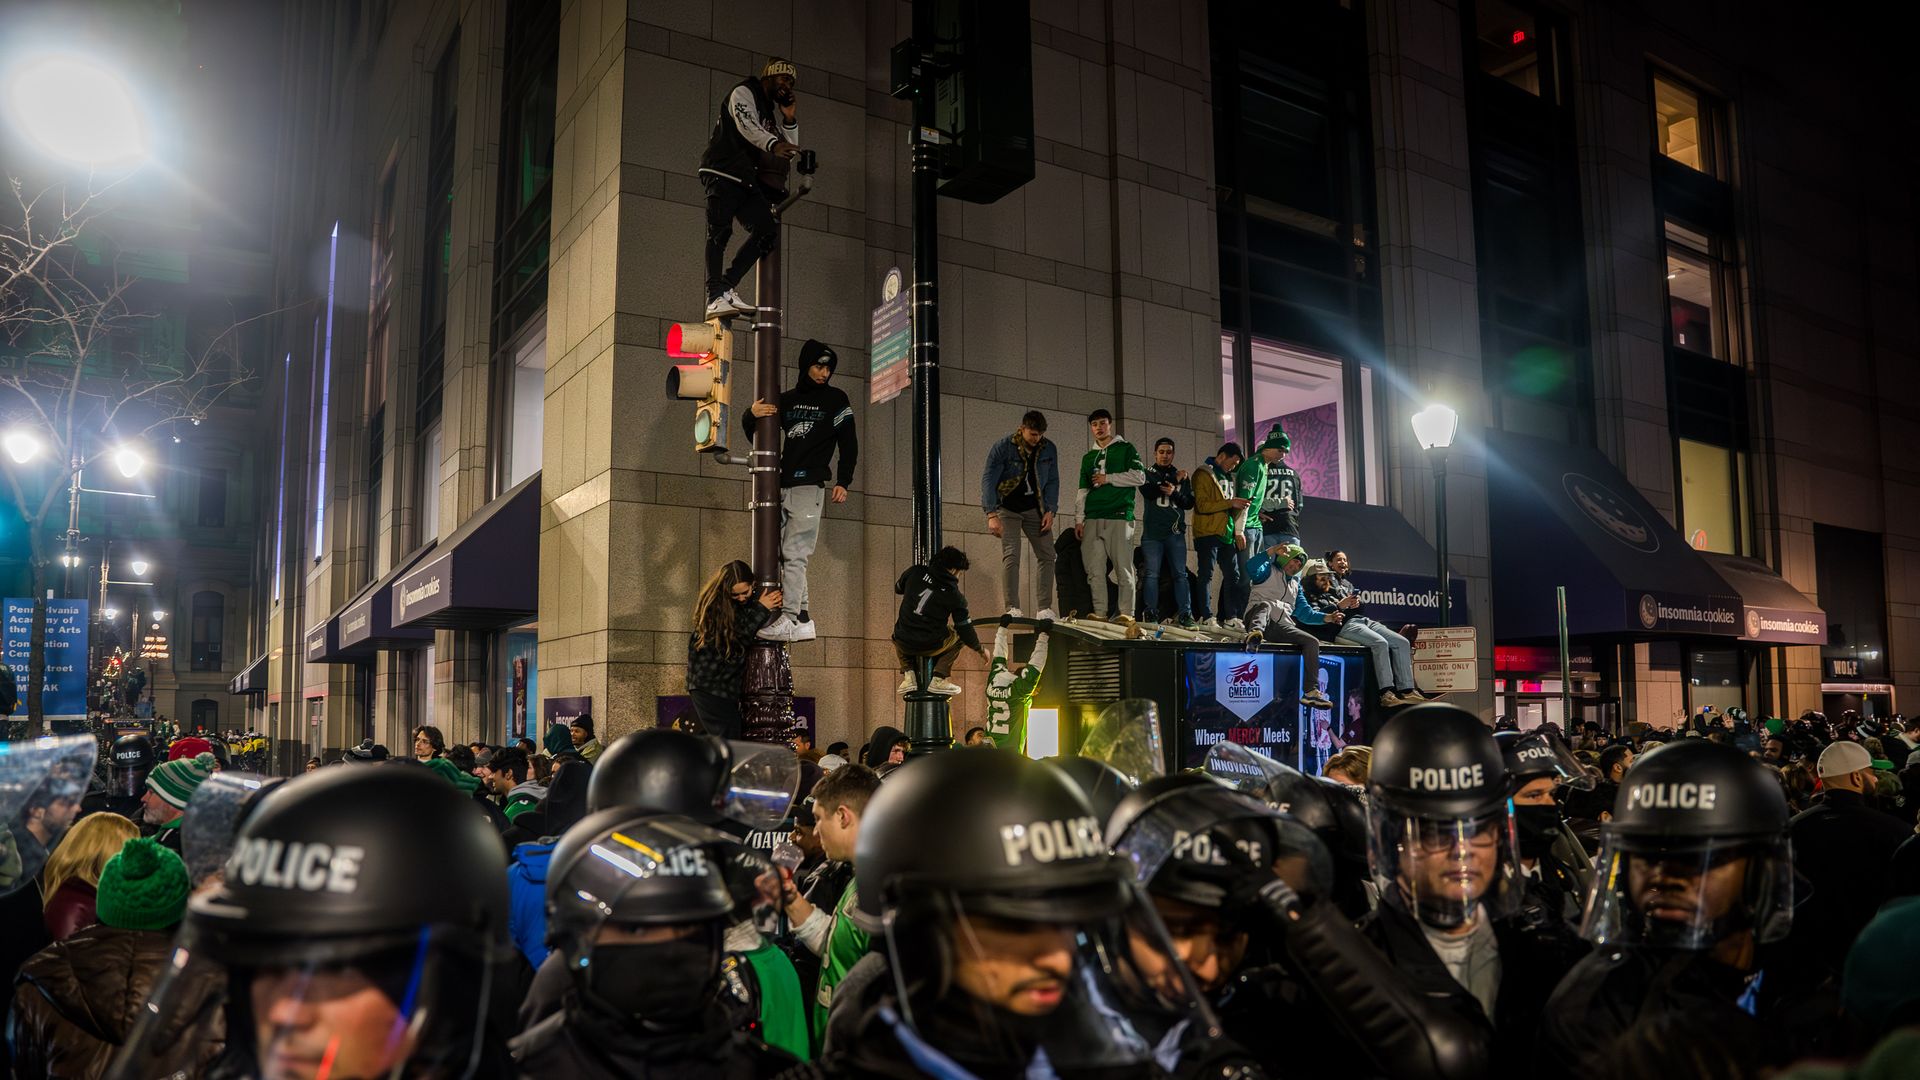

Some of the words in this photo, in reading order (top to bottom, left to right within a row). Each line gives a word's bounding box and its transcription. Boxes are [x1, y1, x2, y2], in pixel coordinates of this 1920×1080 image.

[1266, 479, 1295, 500] 26
[914, 588, 933, 616] 1
[1358, 587, 1405, 606] omnia
[1407, 590, 1453, 609] cookis
[62, 616, 74, 624] of
[1658, 603, 1702, 621] insomnia
[1703, 608, 1735, 624] cookies
[9, 625, 27, 633] the
[58, 626, 81, 634] Arts
[1760, 616, 1794, 631] insomnia
[1794, 620, 1819, 634] cookies
[9, 640, 69, 648] Conntion
[1428, 641, 1461, 649] STOPPING
[9, 664, 30, 672] 30t
[46, 664, 73, 672] treet
[1228, 686, 1260, 698] GMERCYU
[1195, 729, 1226, 746] Where
[1228, 728, 1260, 744] MERCY
[1263, 728, 1290, 743] Meets
[116, 751, 141, 760] POLICE
[1409, 763, 1485, 791] POLICE
[1627, 783, 1716, 811] POLICE
[225, 835, 366, 894] POLICE
